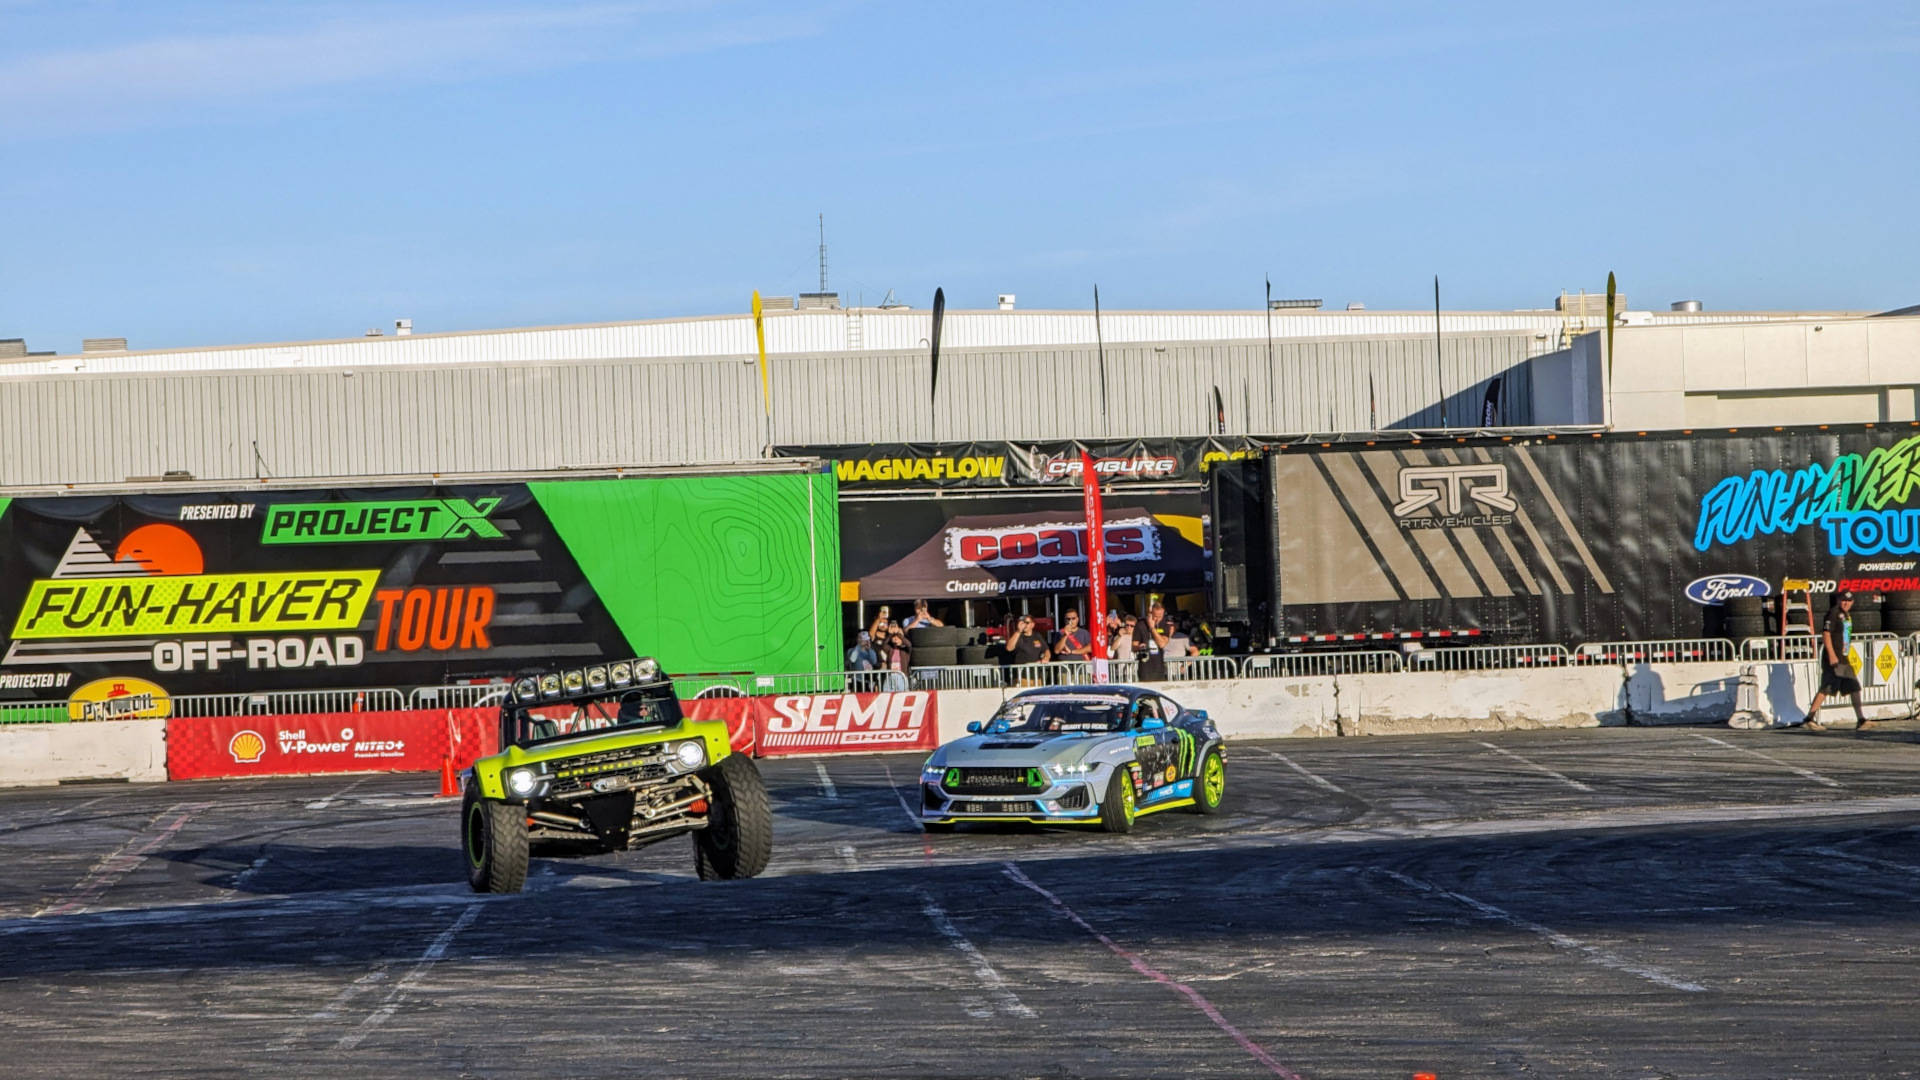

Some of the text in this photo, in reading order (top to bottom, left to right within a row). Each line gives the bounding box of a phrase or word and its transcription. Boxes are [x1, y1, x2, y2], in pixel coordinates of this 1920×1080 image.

[837, 456, 1004, 481] MAGNAFLOW
[1394, 464, 1517, 516] RTR
[180, 504, 256, 520] PRESENTED BY
[270, 497, 504, 539] PROJECT X
[1400, 515, 1512, 528] RTR VEHICLES
[1824, 513, 1920, 552] TOU
[1858, 561, 1916, 572] POWERED BY
[946, 573, 1165, 593] Changing Americas Tire ince 1947
[1702, 579, 1753, 601] Ford
[25, 579, 362, 630] FUN-HAVER
[375, 586, 495, 652] TOUR
[153, 636, 364, 672] OFF-ROAD
[0, 673, 71, 688] PROTECTED BY
[768, 691, 929, 733] SEMA
[279, 729, 306, 741] Shell
[845, 731, 916, 742] SHOW
[280, 740, 349, 754] V-Power
[557, 760, 644, 779] BRONCO
